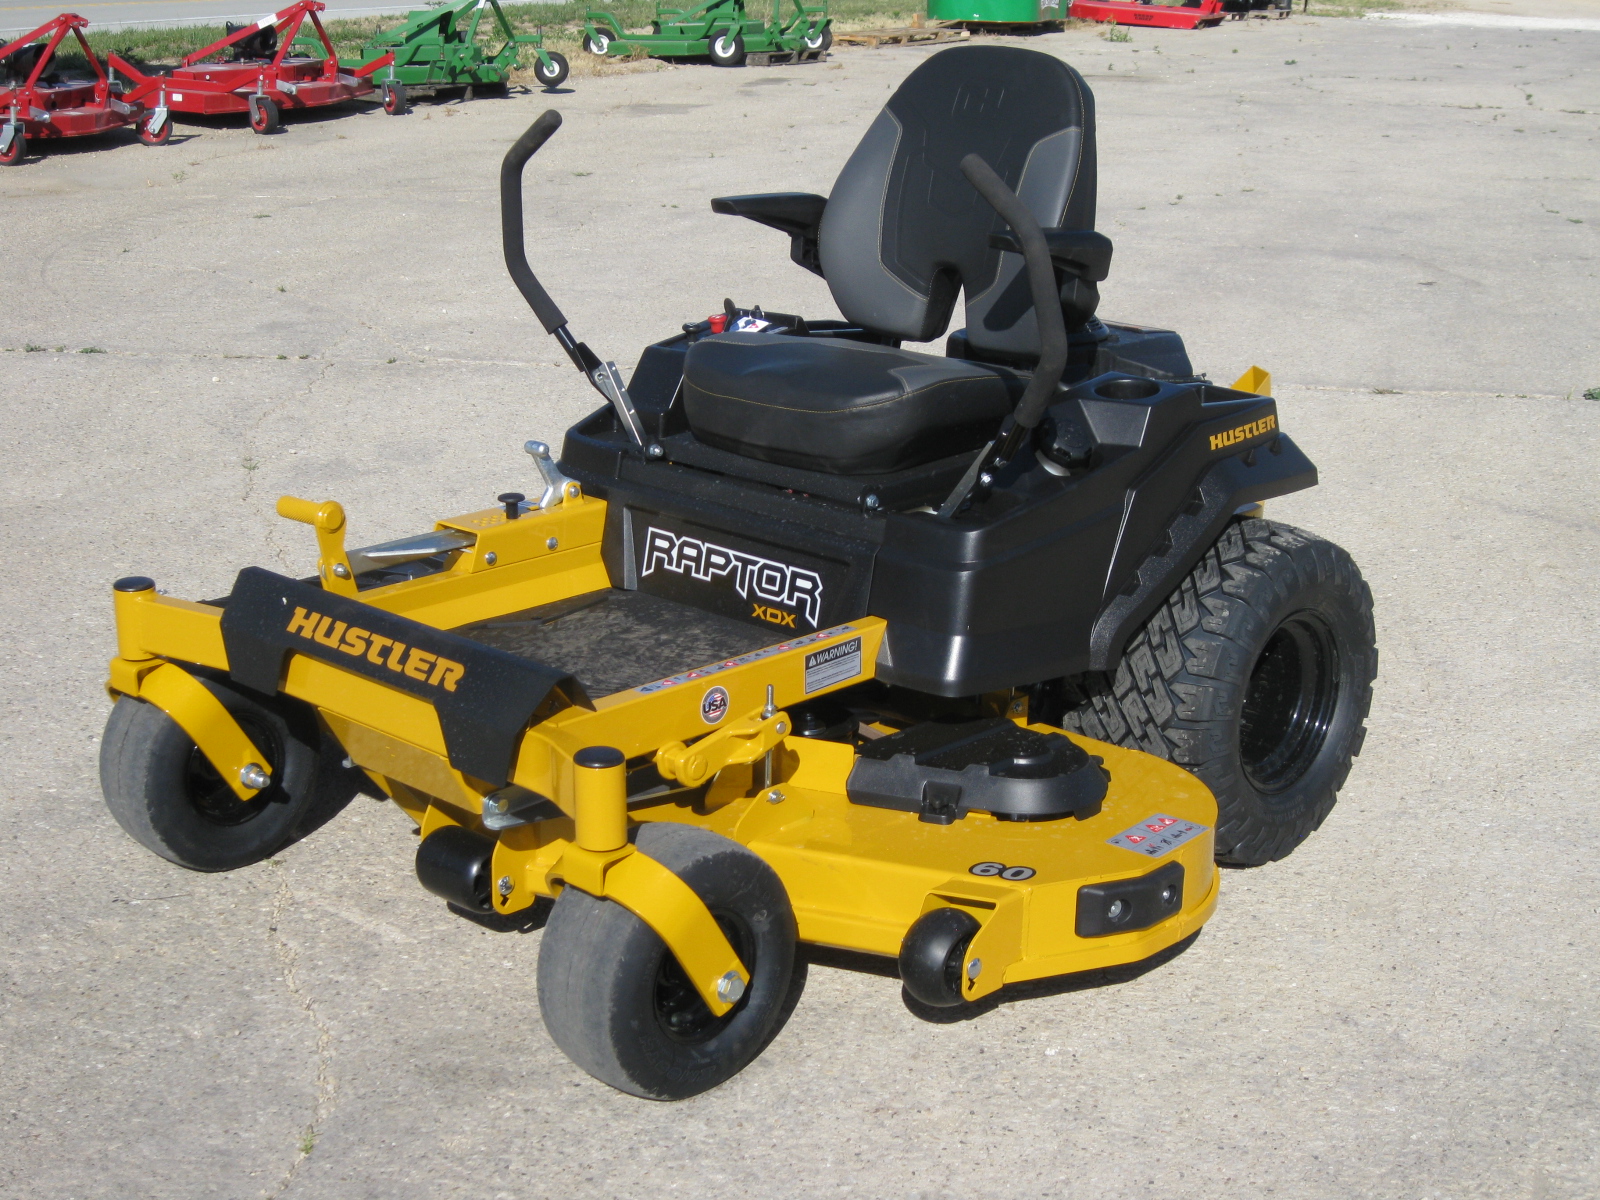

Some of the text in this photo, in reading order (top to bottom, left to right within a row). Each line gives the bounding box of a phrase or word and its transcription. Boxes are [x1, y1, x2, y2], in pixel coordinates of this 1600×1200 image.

[1209, 414, 1276, 450] HUSTLER
[642, 526, 823, 628] RAPTOR
[751, 604, 796, 628] XDX
[286, 606, 465, 692] HUSTLER
[816, 640, 858, 664] WARNING!
[702, 697, 727, 714] USA
[969, 862, 1036, 881] 60
